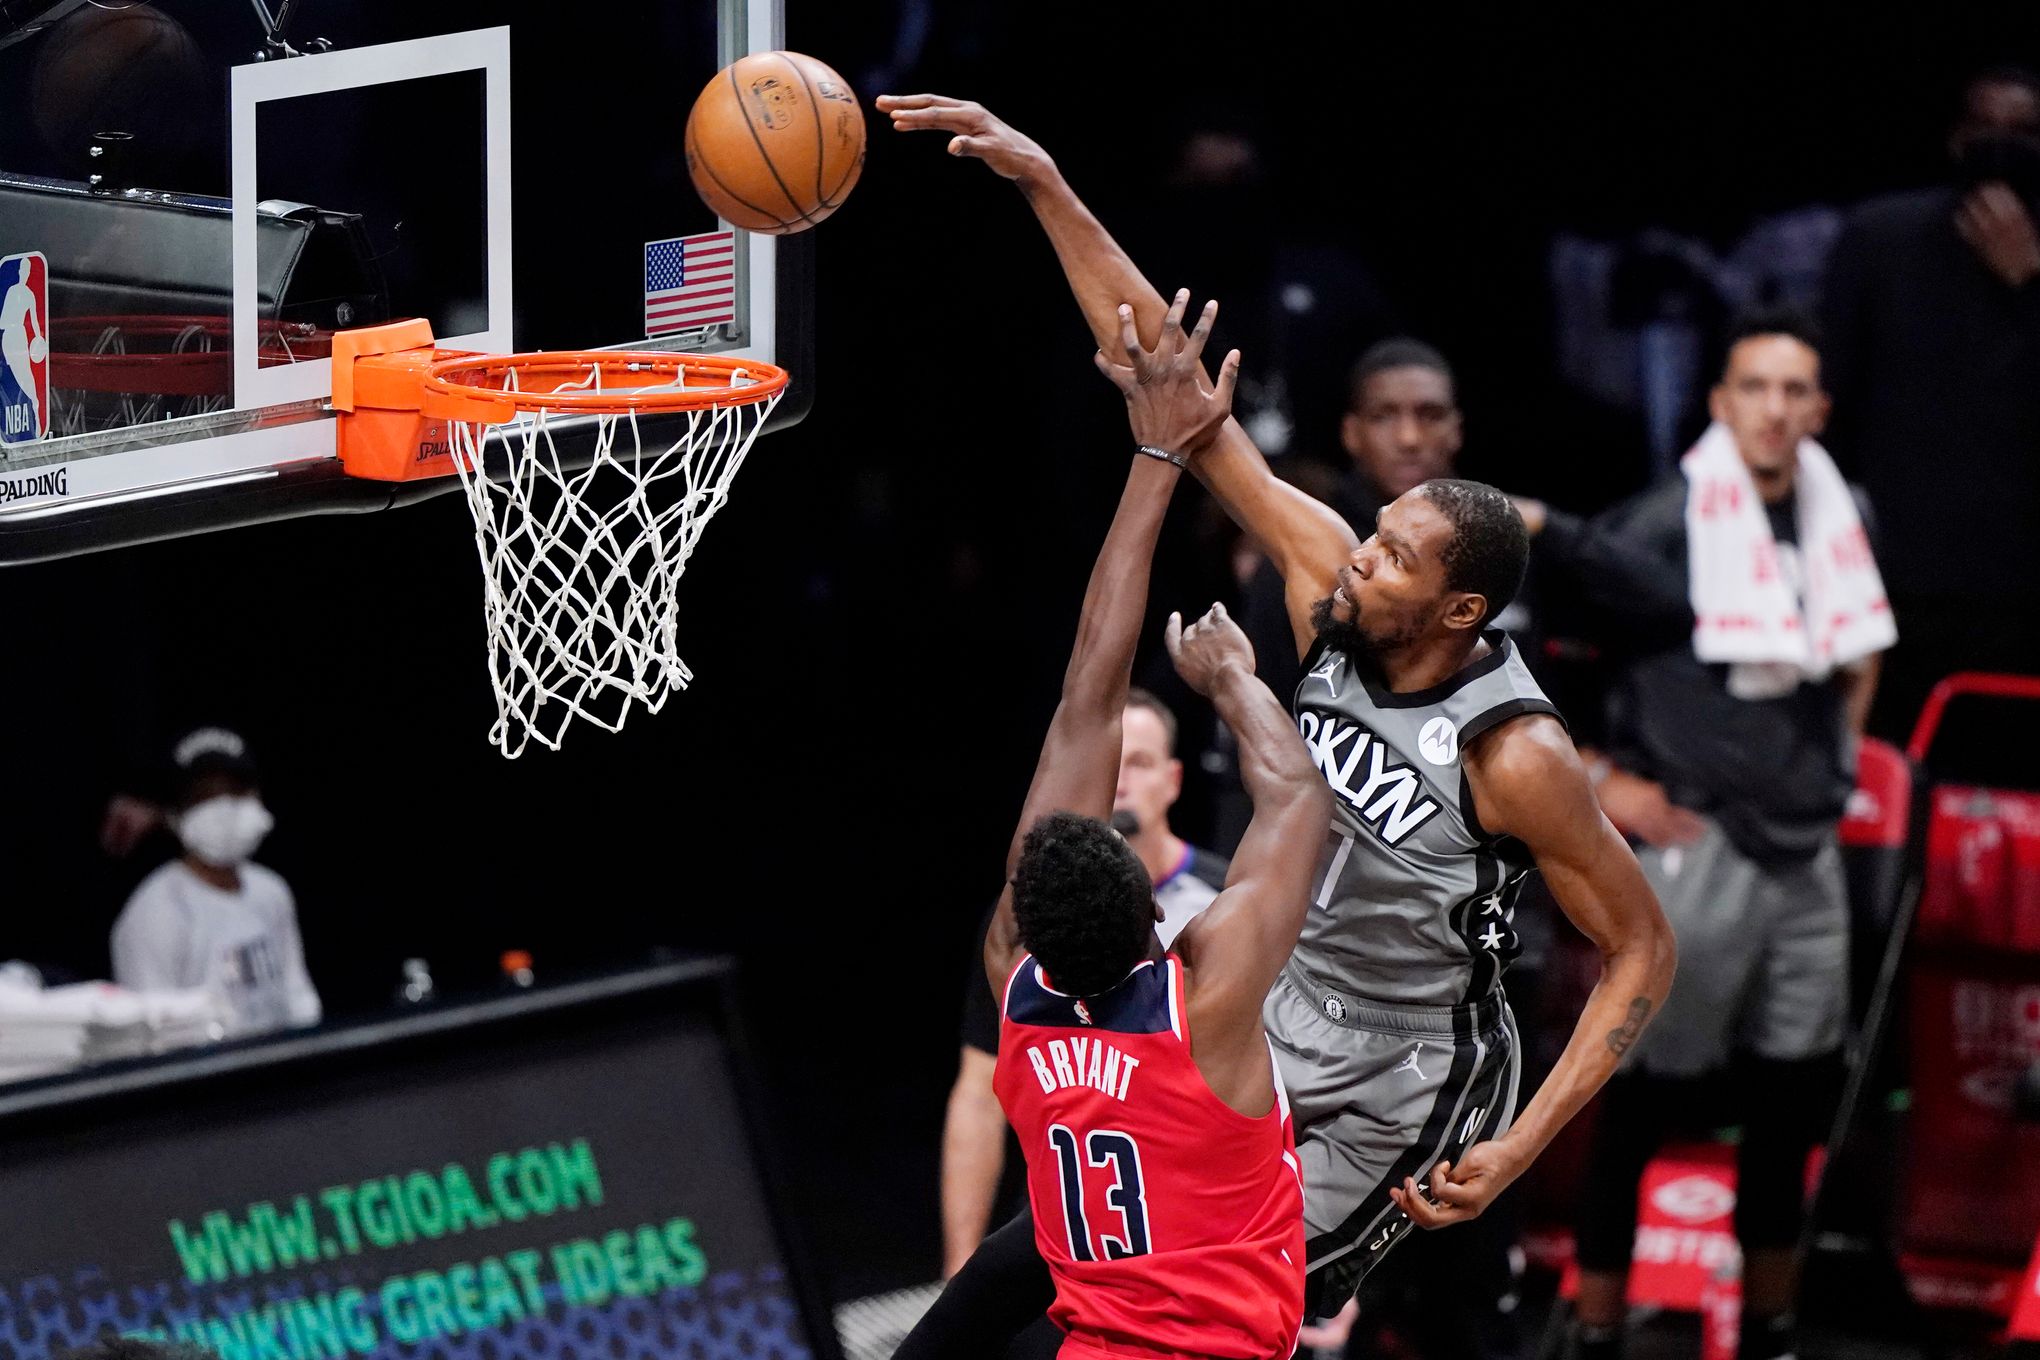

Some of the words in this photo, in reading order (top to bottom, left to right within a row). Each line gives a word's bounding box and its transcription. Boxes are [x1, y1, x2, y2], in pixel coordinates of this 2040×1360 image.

[5, 403, 30, 435] NBA
[416, 434, 474, 461] SPAL
[1316, 819, 1356, 911] 7
[1027, 1036, 1140, 1102] BRYANT
[168, 1137, 604, 1285] WWW.TGIOA.COM
[1048, 1123, 1153, 1262] 13
[378, 1249, 547, 1343] GREAT
[551, 1217, 707, 1307] IDEAS
